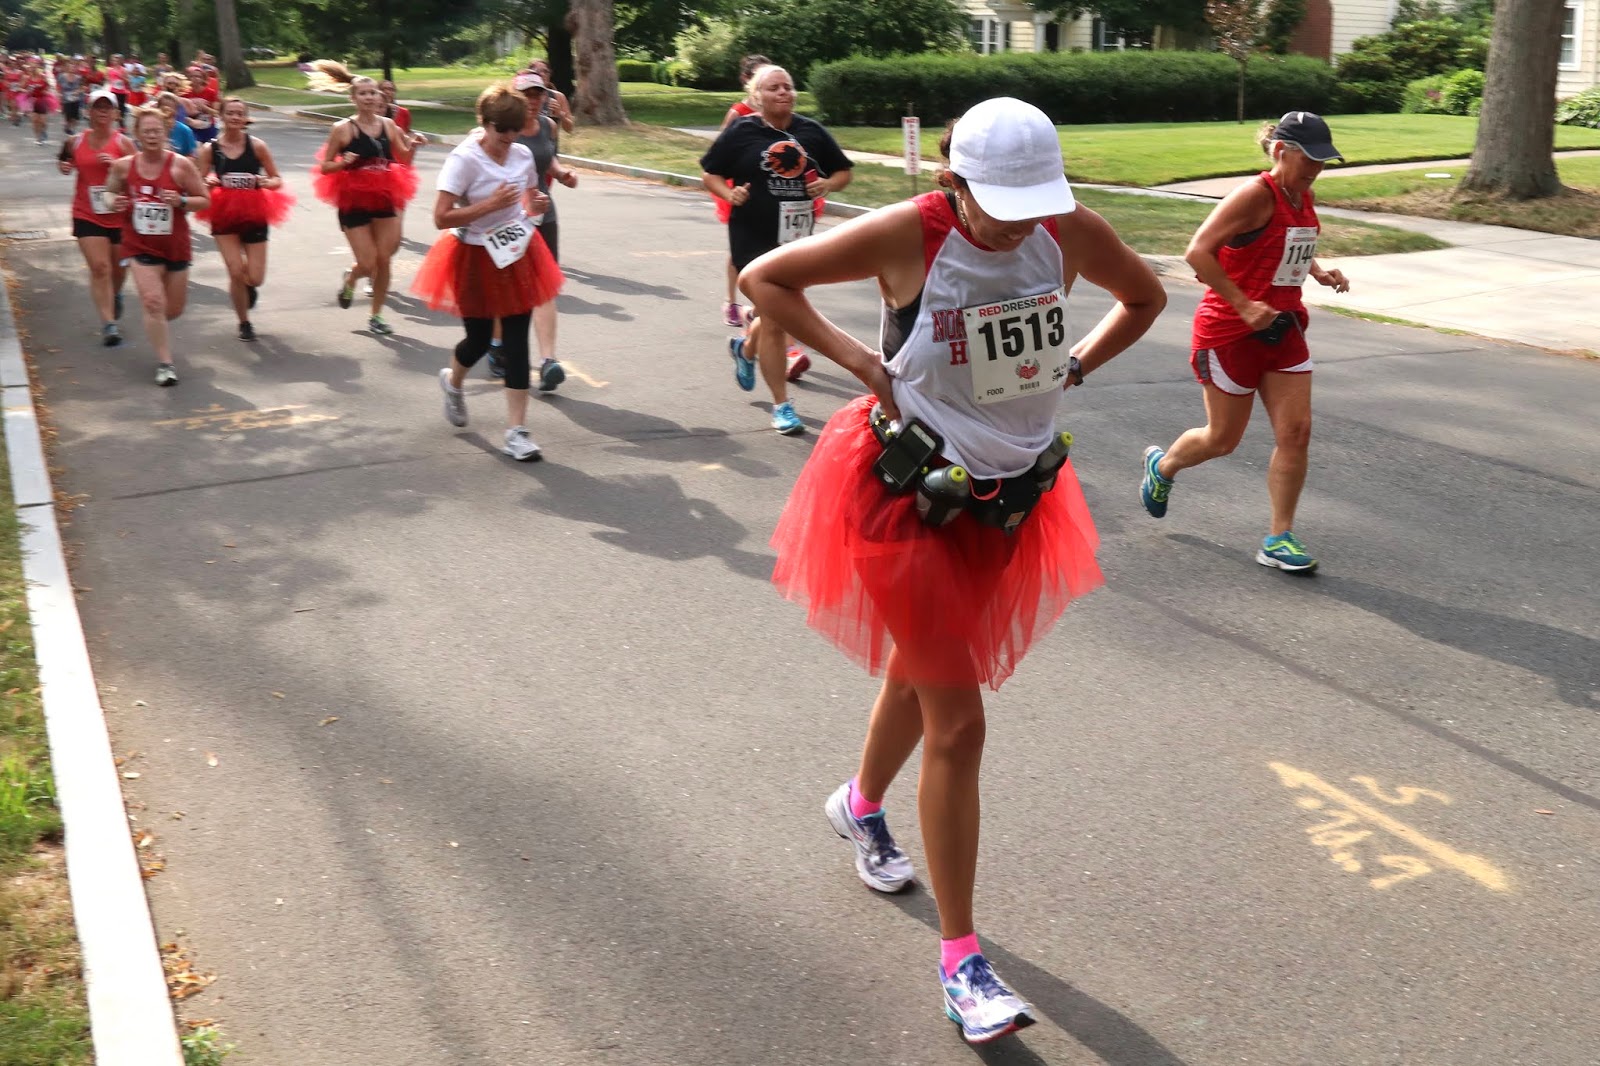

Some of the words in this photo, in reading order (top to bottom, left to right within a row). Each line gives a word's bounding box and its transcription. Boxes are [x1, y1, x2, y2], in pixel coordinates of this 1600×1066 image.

[488, 224, 526, 249] 1585
[978, 306, 1065, 361] 1513
[986, 387, 1005, 397] FOOD
